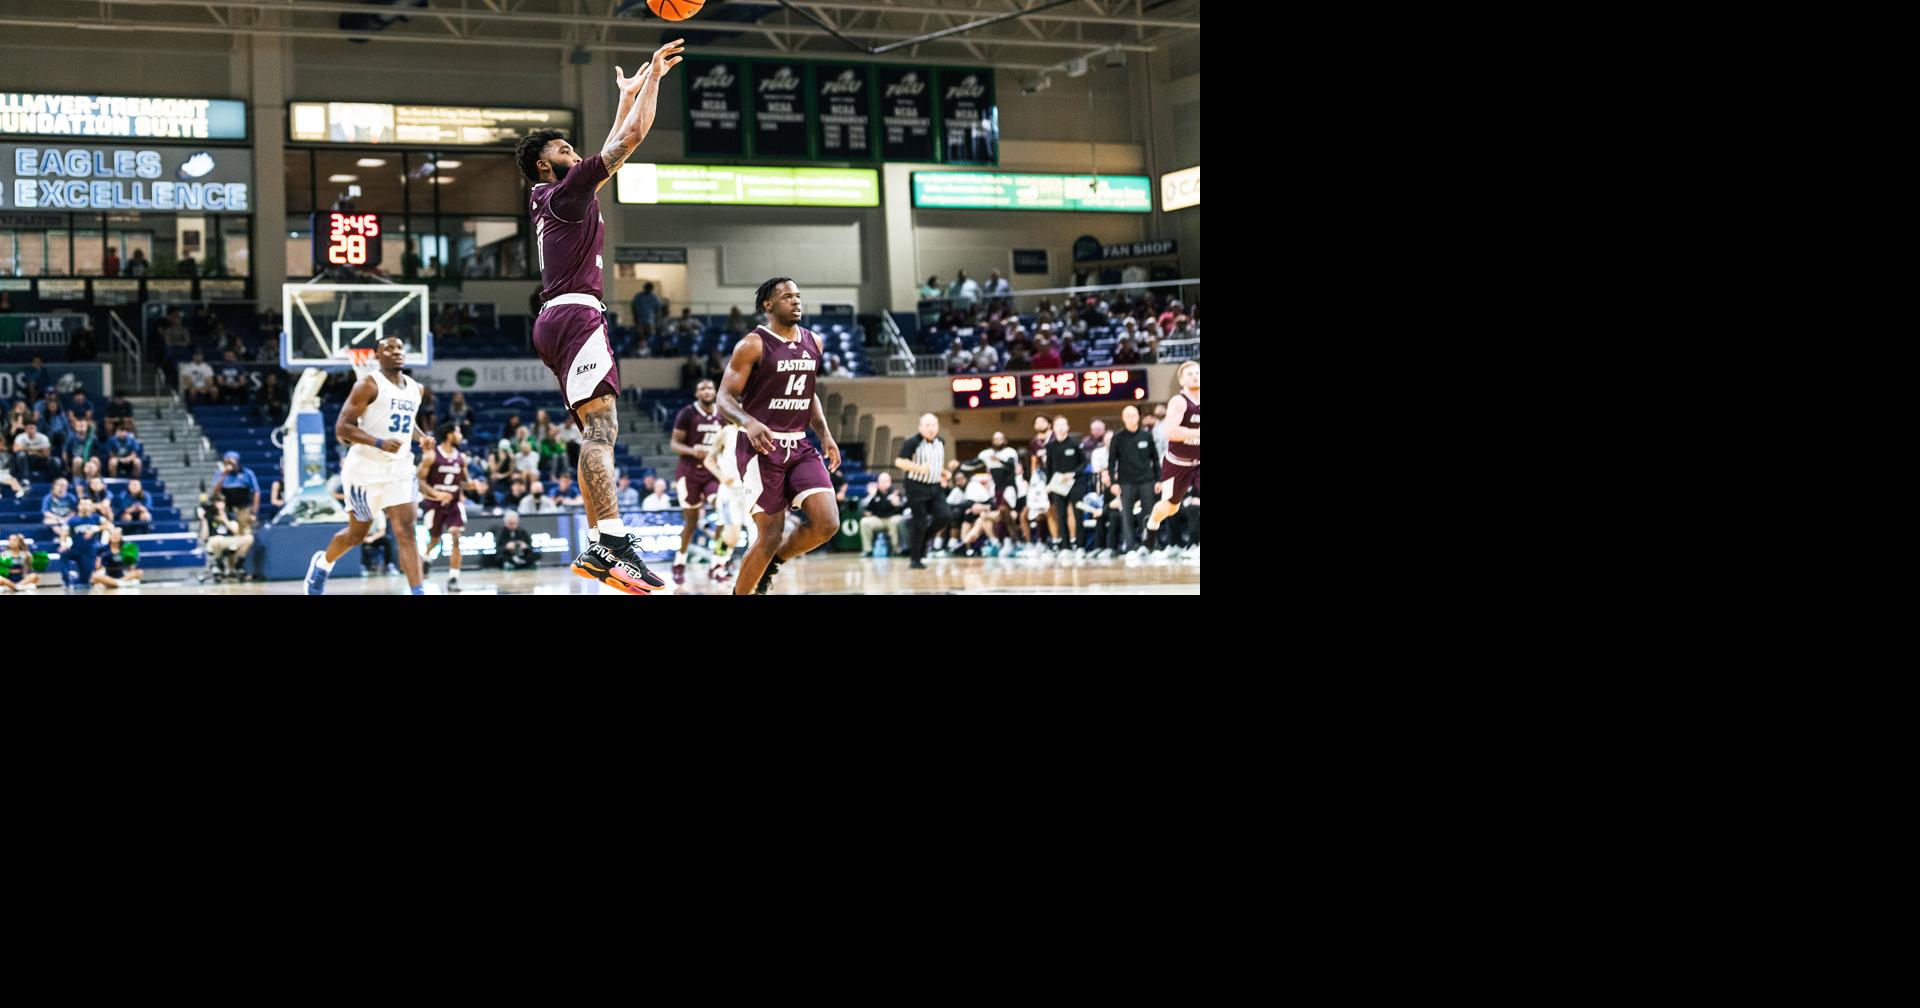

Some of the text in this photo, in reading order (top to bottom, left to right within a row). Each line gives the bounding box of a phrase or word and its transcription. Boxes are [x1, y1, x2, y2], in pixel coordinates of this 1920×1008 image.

[0, 112, 130, 136] UNDATION
[15, 147, 162, 179] EAGLES
[14, 178, 248, 210] EXCELLENCE
[330, 213, 379, 237] 3:45
[329, 234, 366, 264] 28
[1103, 240, 1172, 258] FAN SHOP
[576, 363, 597, 375] EKU
[777, 360, 816, 372] EASTERN
[785, 374, 807, 396] 14
[989, 376, 1016, 400] 30
[1032, 373, 1076, 397] 3:45
[1083, 370, 1111, 395] 23
[388, 413, 411, 433] 32
[592, 544, 642, 580] FIVE DEEP
